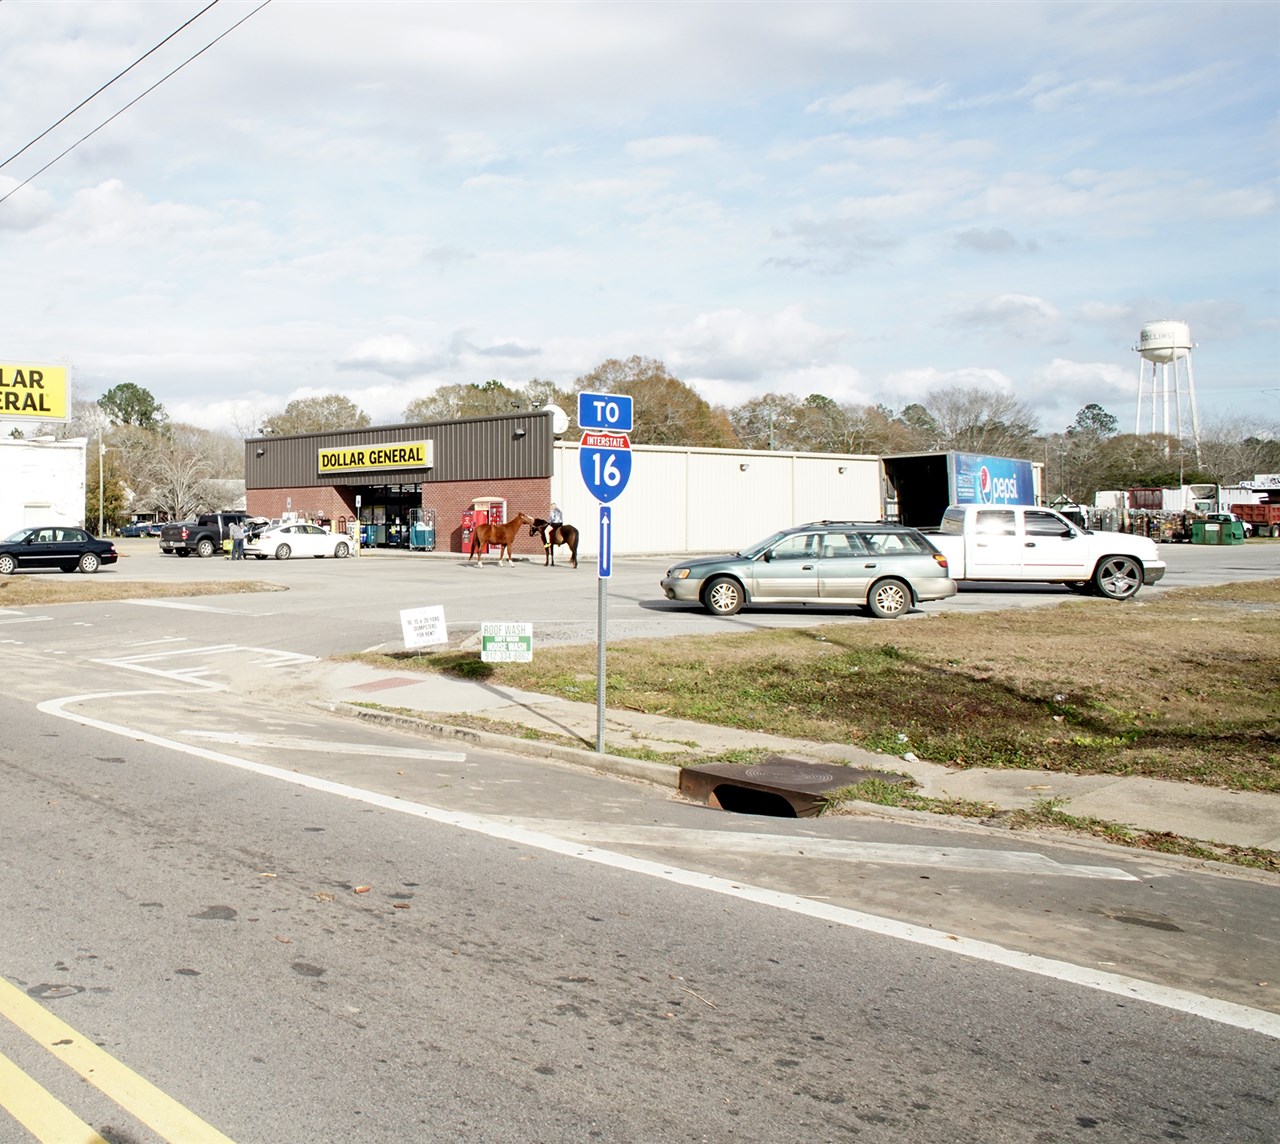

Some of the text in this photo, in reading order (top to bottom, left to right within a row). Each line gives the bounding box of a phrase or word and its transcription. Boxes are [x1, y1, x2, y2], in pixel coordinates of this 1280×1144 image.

[593, 401, 619, 423] TO
[586, 435, 624, 447] INTERSTATE
[321, 447, 423, 467] DOLLAR GENERAL
[592, 453, 621, 487] 16
[992, 473, 1018, 504] pepsi
[484, 624, 526, 635] ROOF WASH
[487, 642, 527, 651] HOUSE WASH
